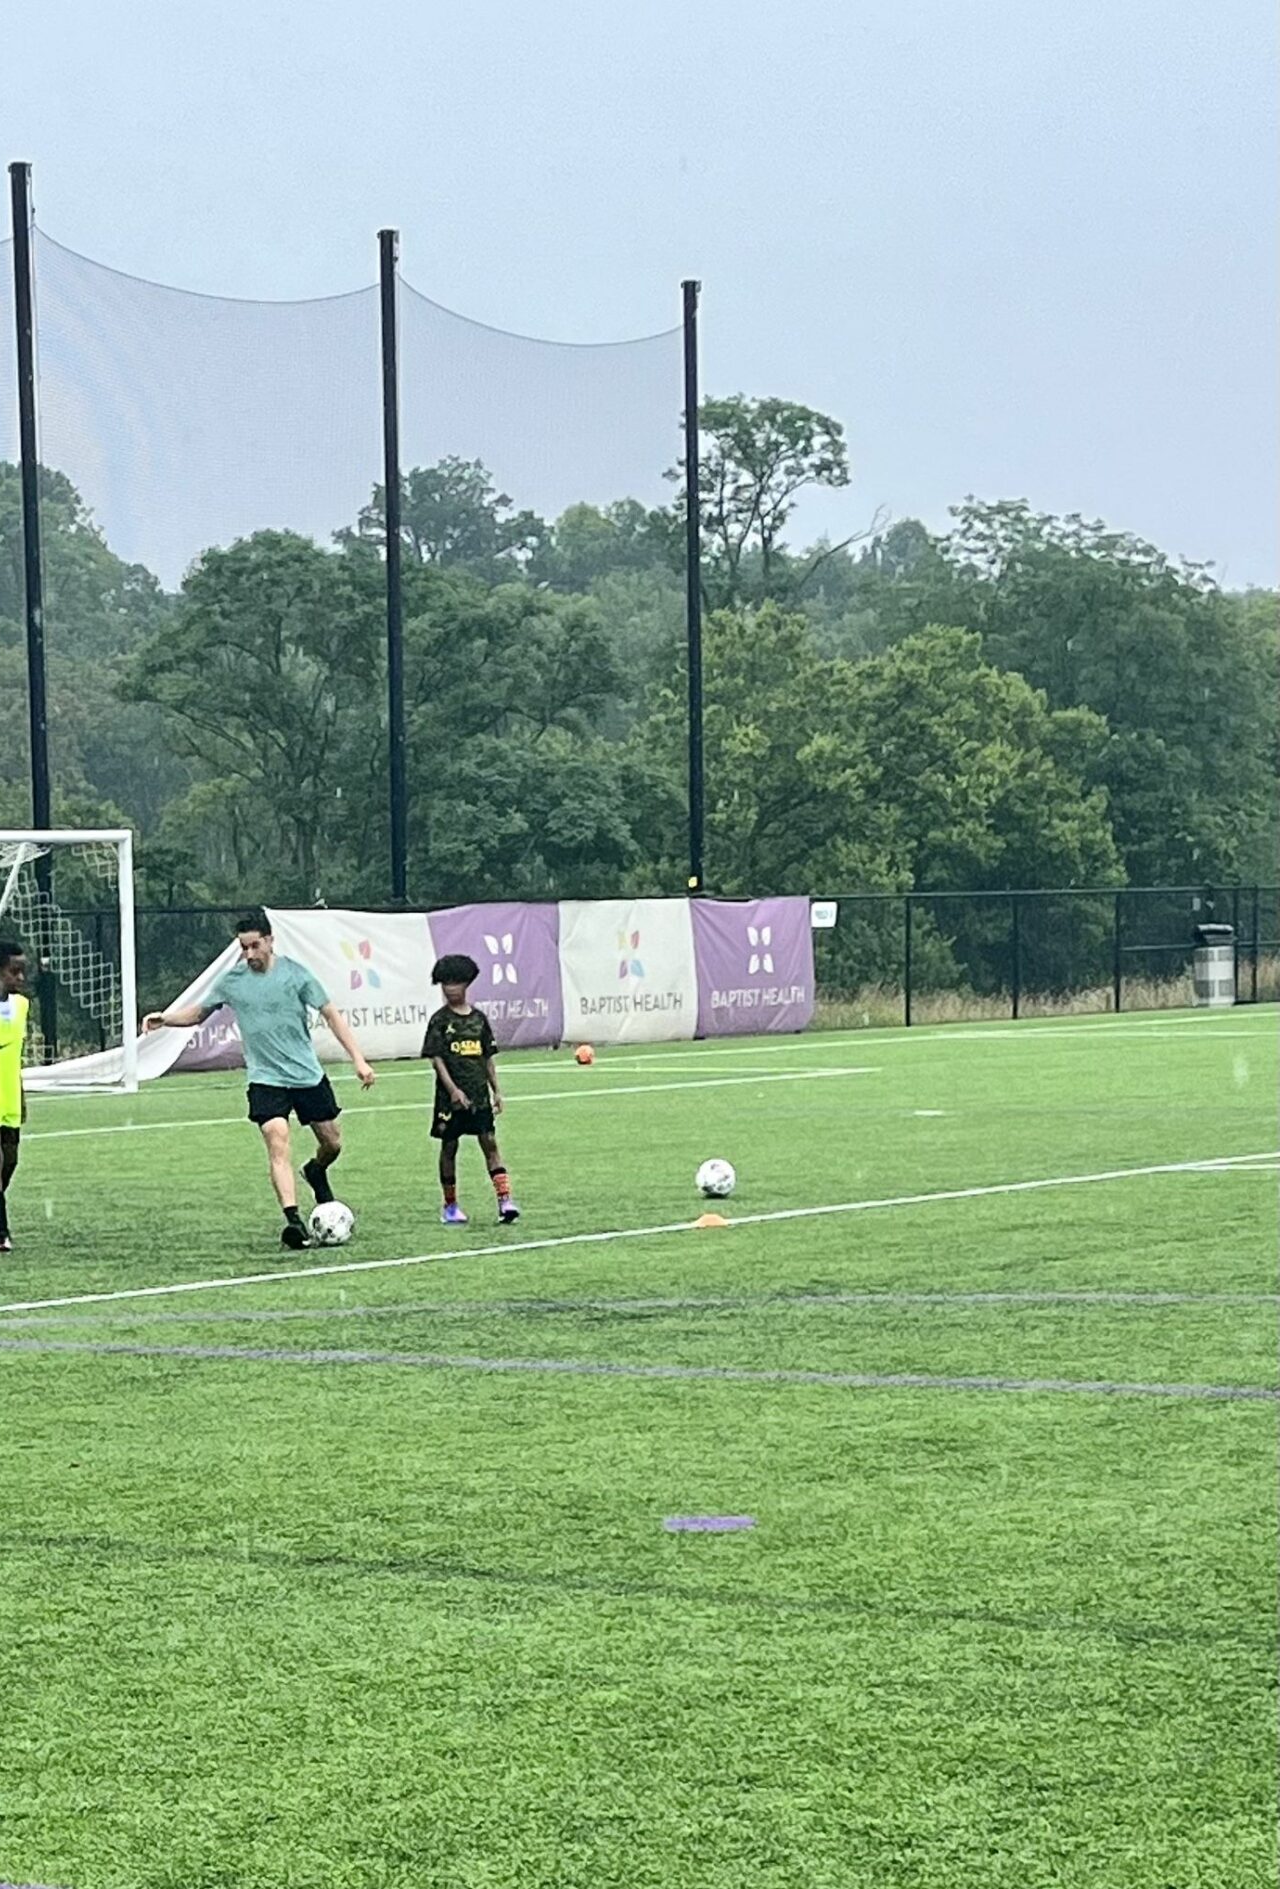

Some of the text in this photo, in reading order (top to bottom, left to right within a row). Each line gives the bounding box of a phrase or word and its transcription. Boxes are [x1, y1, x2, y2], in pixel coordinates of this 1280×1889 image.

[581, 992, 682, 1015] BAPTIST HEALTH
[711, 985, 805, 1009] BAPTIST HEALTH
[373, 1005, 427, 1026] HEALTH
[507, 999, 549, 1019] HEALTH
